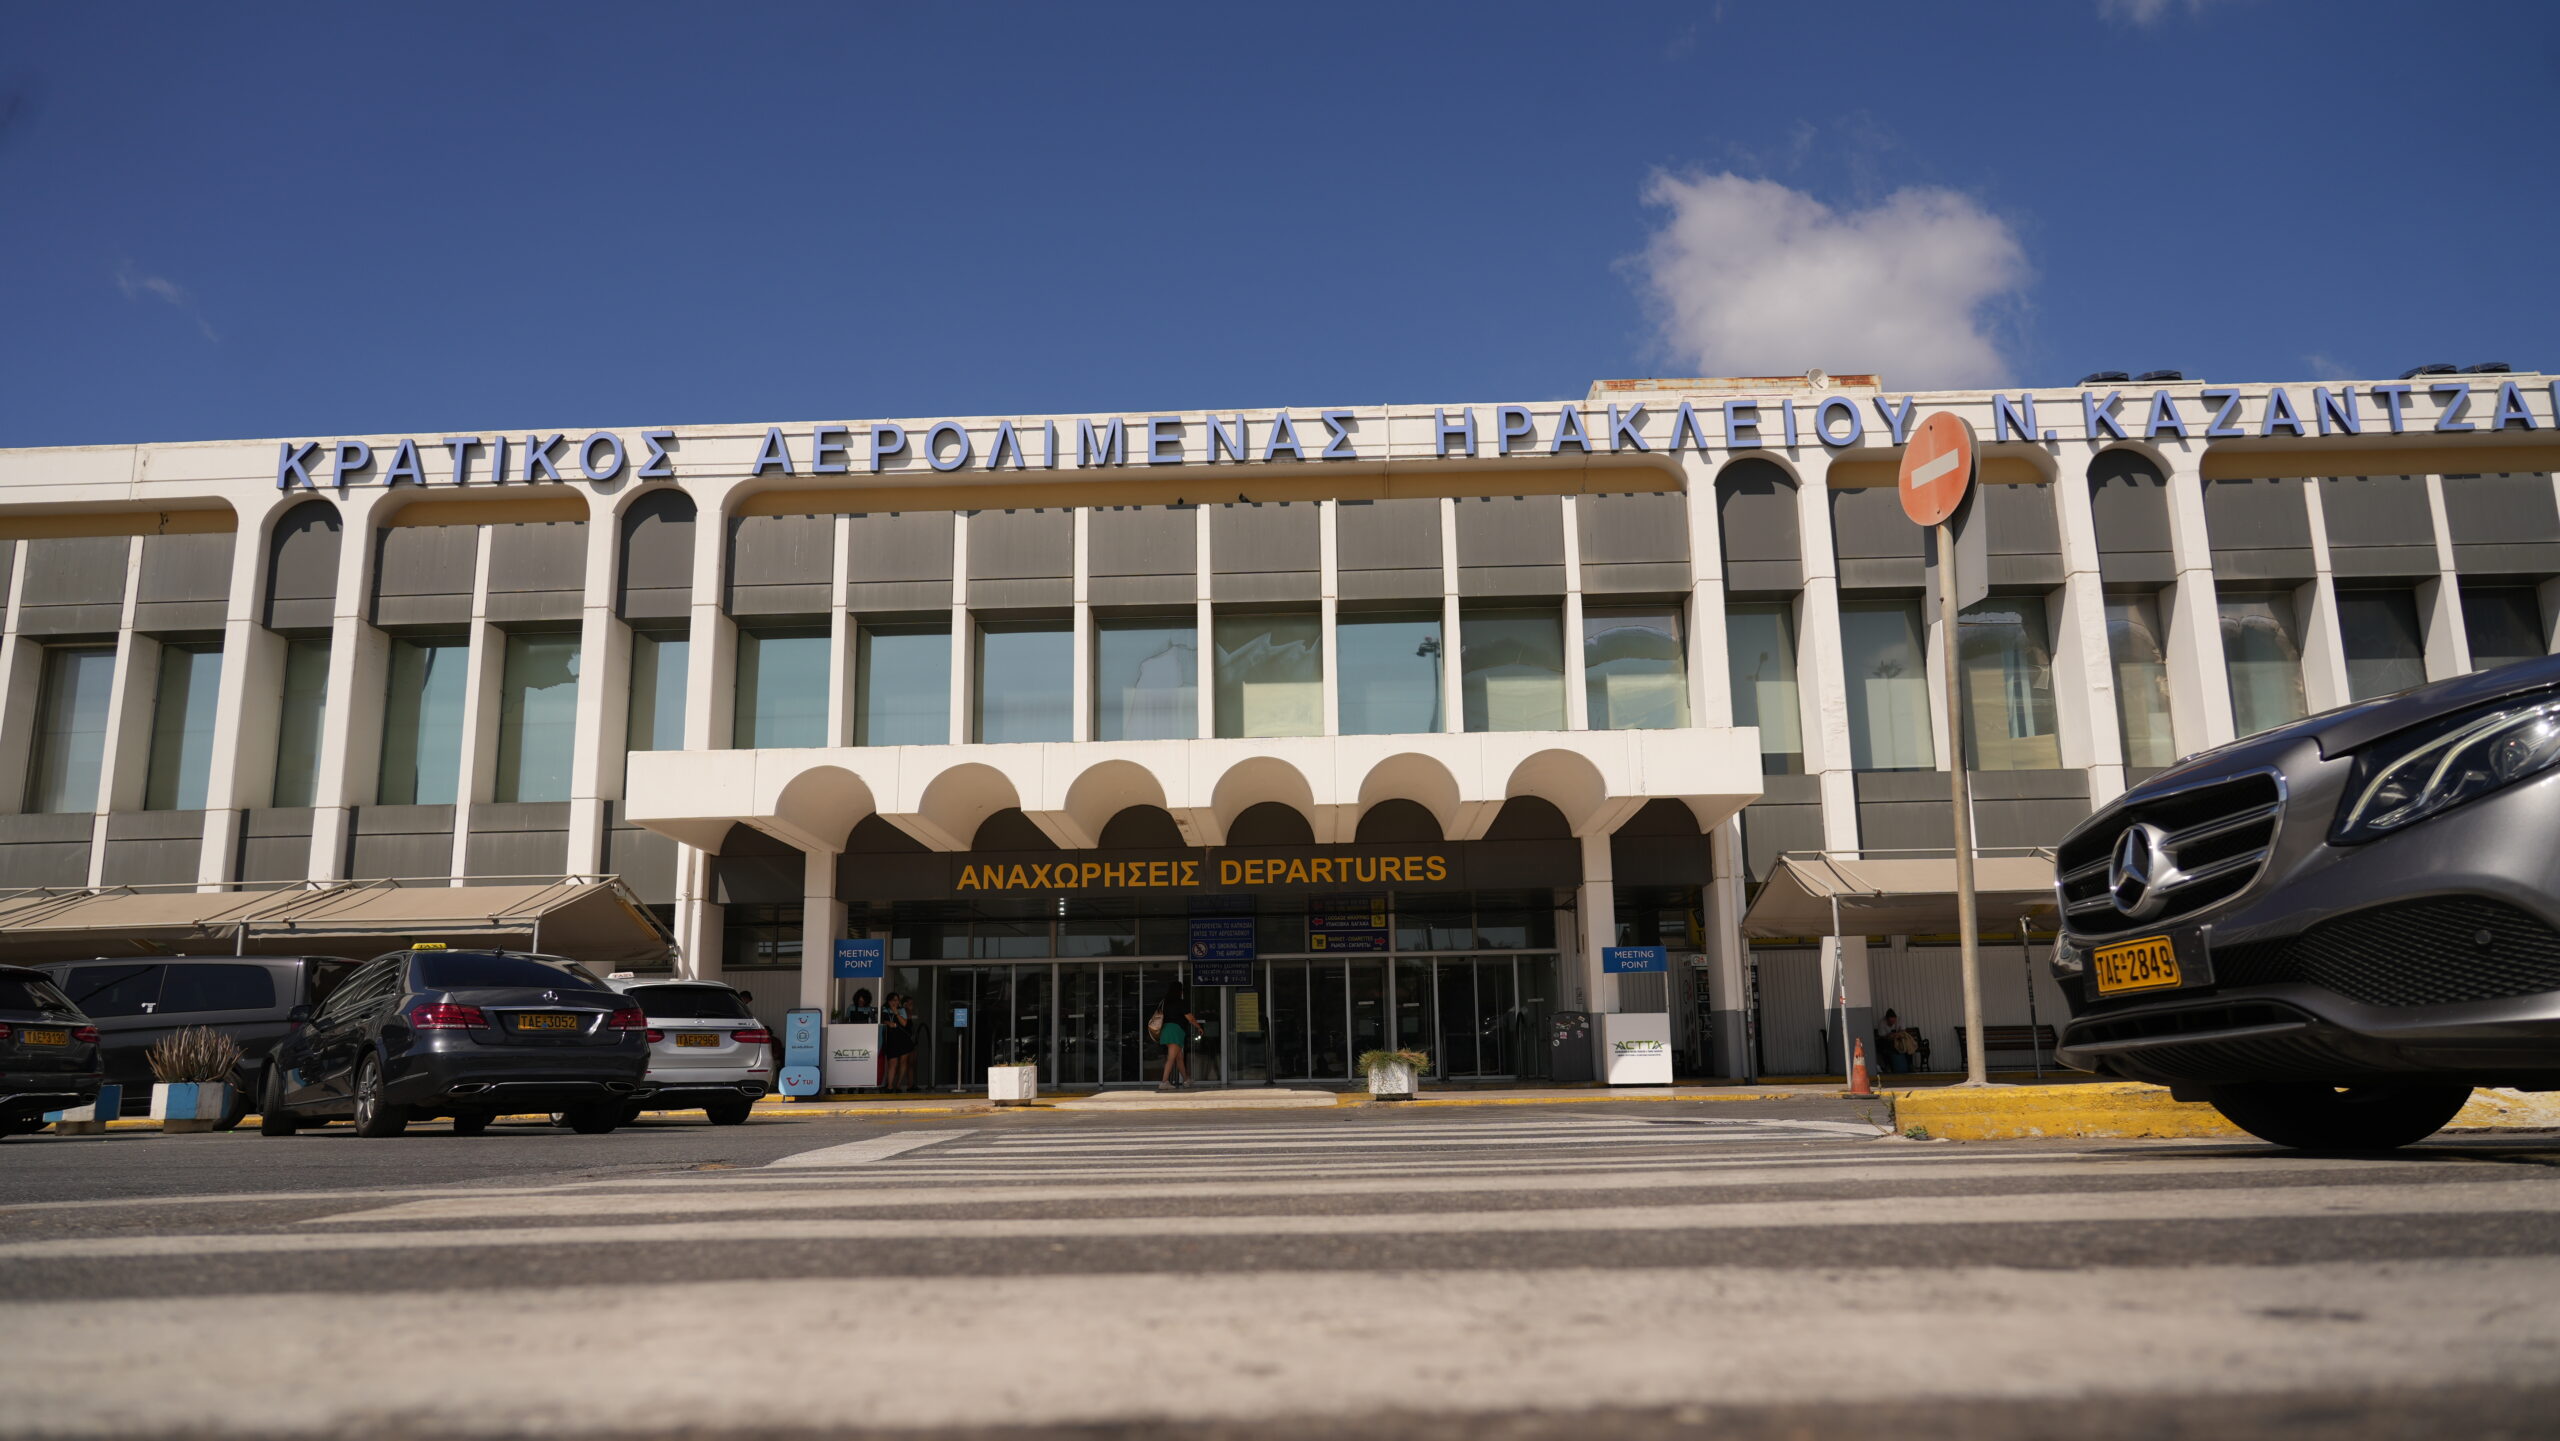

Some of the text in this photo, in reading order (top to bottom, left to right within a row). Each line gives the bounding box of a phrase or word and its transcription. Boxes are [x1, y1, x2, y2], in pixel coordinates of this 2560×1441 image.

[276, 380, 2560, 489] ΚΡΑΤΙΚΟΣ ΑΕΡΟΛΙΜΕΝΑΣ ΗΡΑΚΛΕΙΟΥ Ν. ΚΑΖΑΝΤΖΑ
[957, 856, 1447, 890] ΑΝΑΧΩΡΗΣΕΙΣ DEPARTURES
[838, 949, 880, 959] MEETING
[1614, 950, 1655, 959] MEETING
[844, 960, 873, 968] POINT
[1621, 960, 1649, 969] POINT
[1613, 1040, 1664, 1050] ACTTA
[834, 1049, 871, 1057] ACTTA
